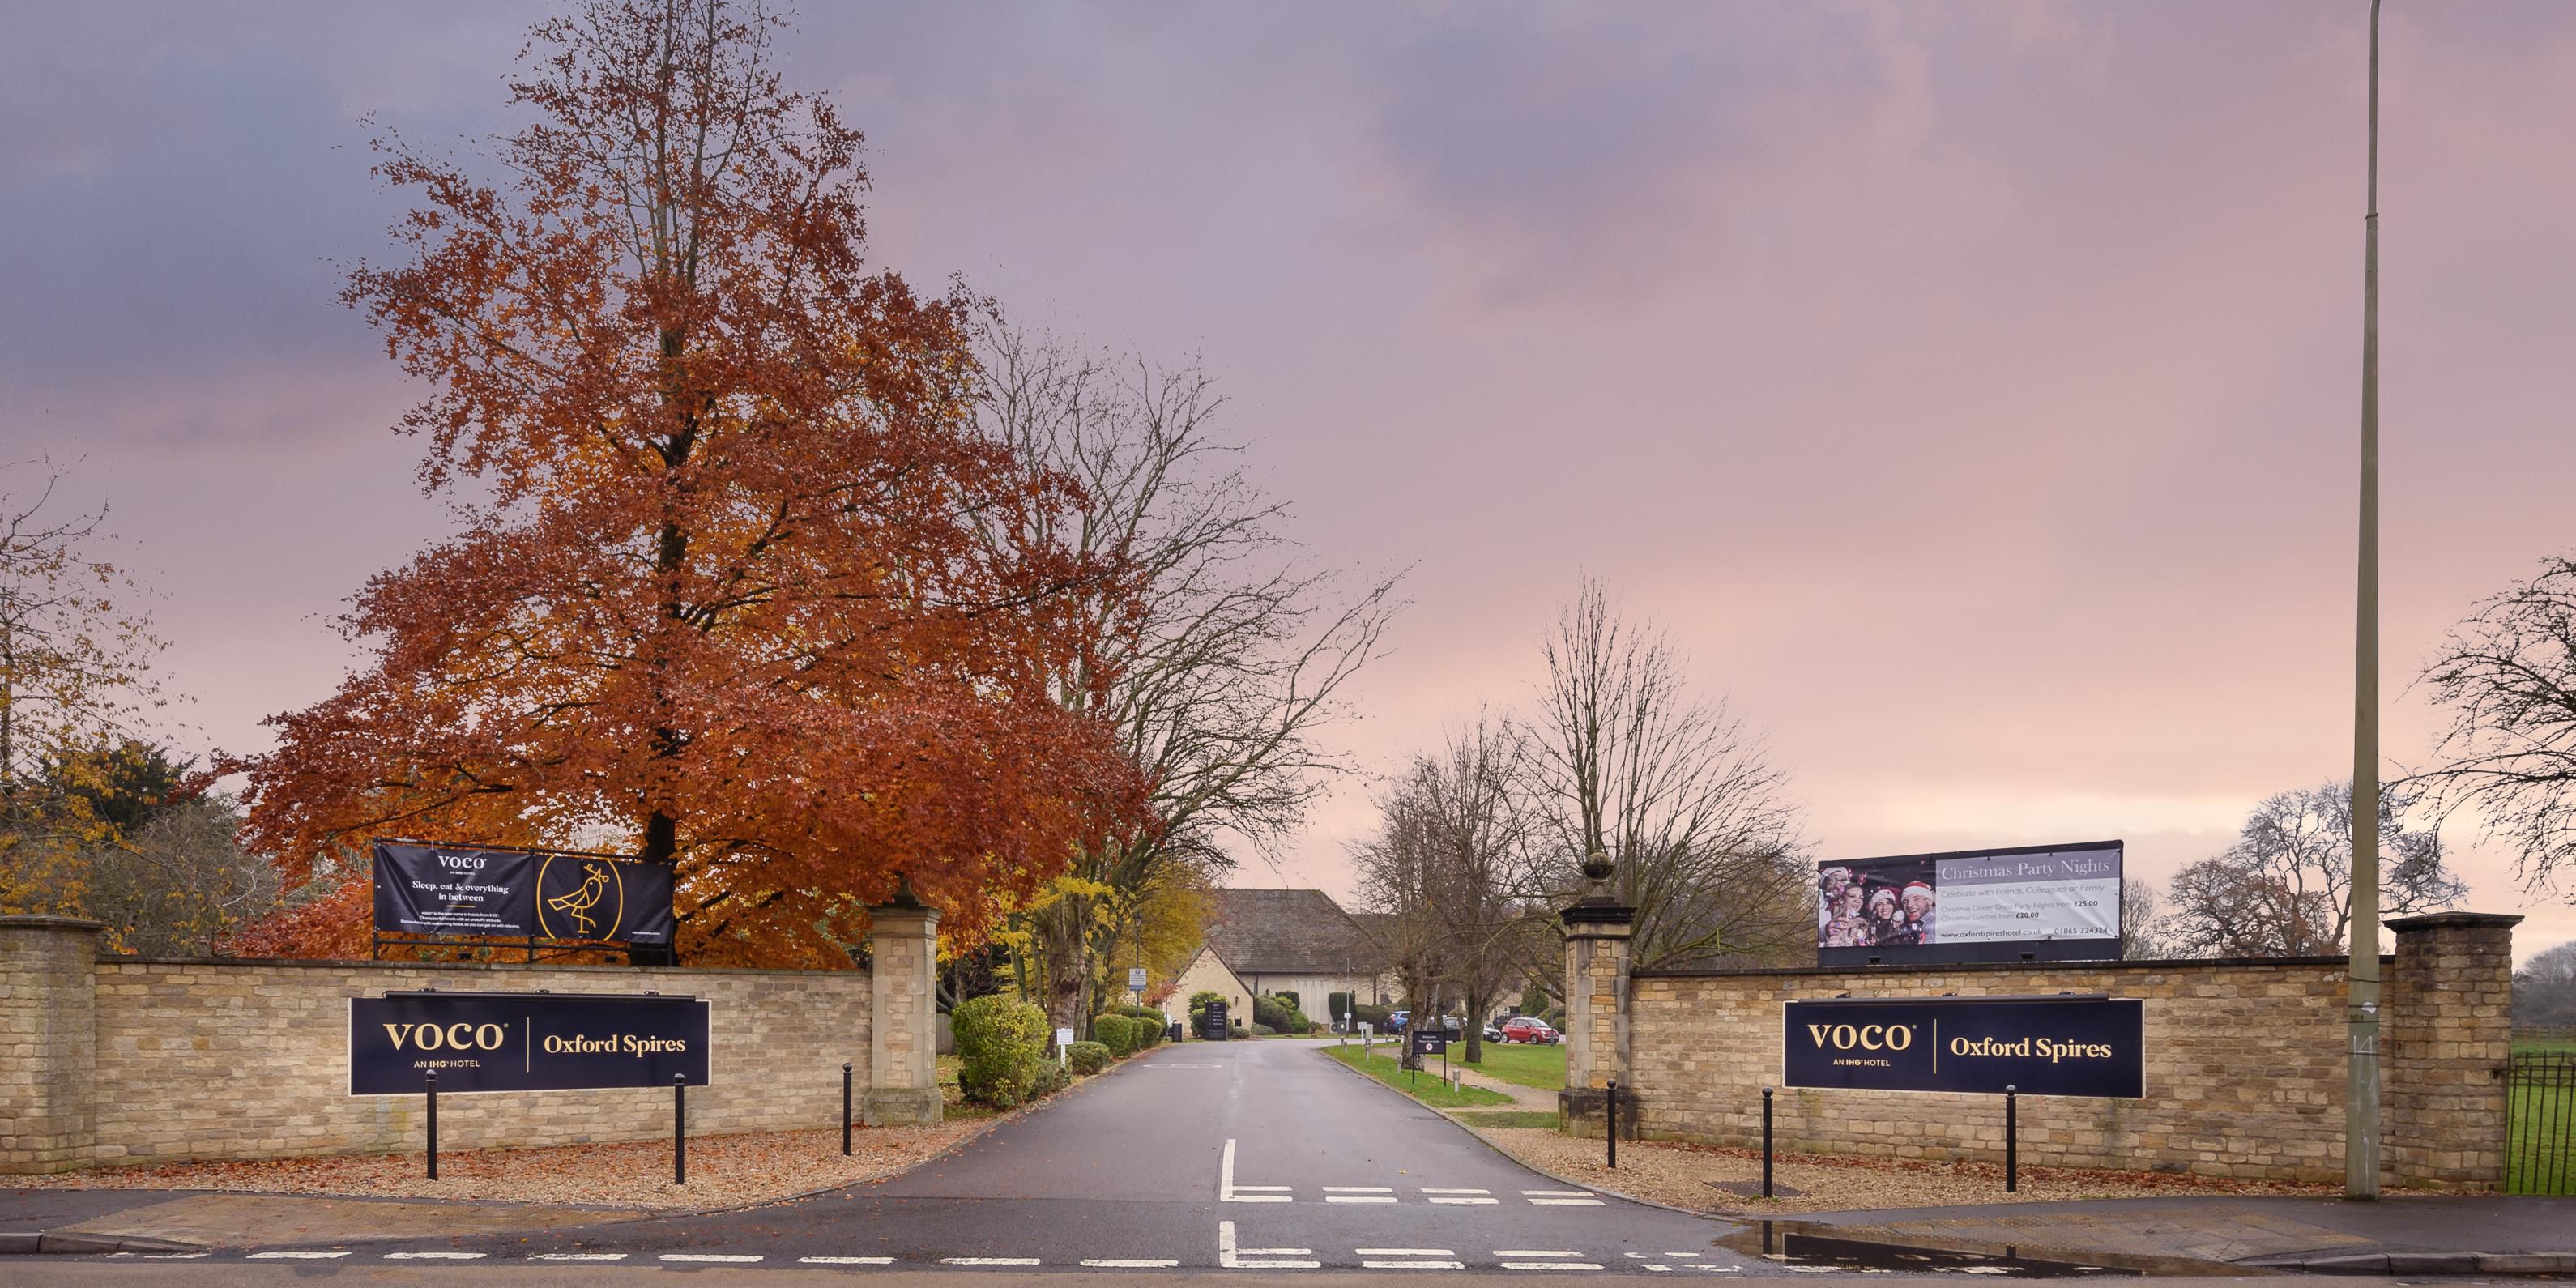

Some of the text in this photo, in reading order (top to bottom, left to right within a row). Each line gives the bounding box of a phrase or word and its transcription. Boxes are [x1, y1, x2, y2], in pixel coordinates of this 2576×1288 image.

[1941, 858, 2110, 881] Christmas Party Nights
[412, 881, 438, 891] Sleep,
[455, 883, 463, 891] &
[465, 884, 510, 894] everything
[1941, 889, 1977, 898] Celebrate
[2026, 886, 2066, 894] Colleagues
[2080, 884, 2105, 893] Family
[449, 893, 484, 902] between
[1941, 928, 2042, 939] www.oxfordspireshotel.co.uk
[2054, 927, 2077, 935] 01865
[544, 1034, 686, 1058] Oxford Spires
[1951, 1037, 2112, 1064] Oxford Spires
[450, 1060, 480, 1068] HOTEL
[1864, 1059, 1891, 1067] HOTEL
